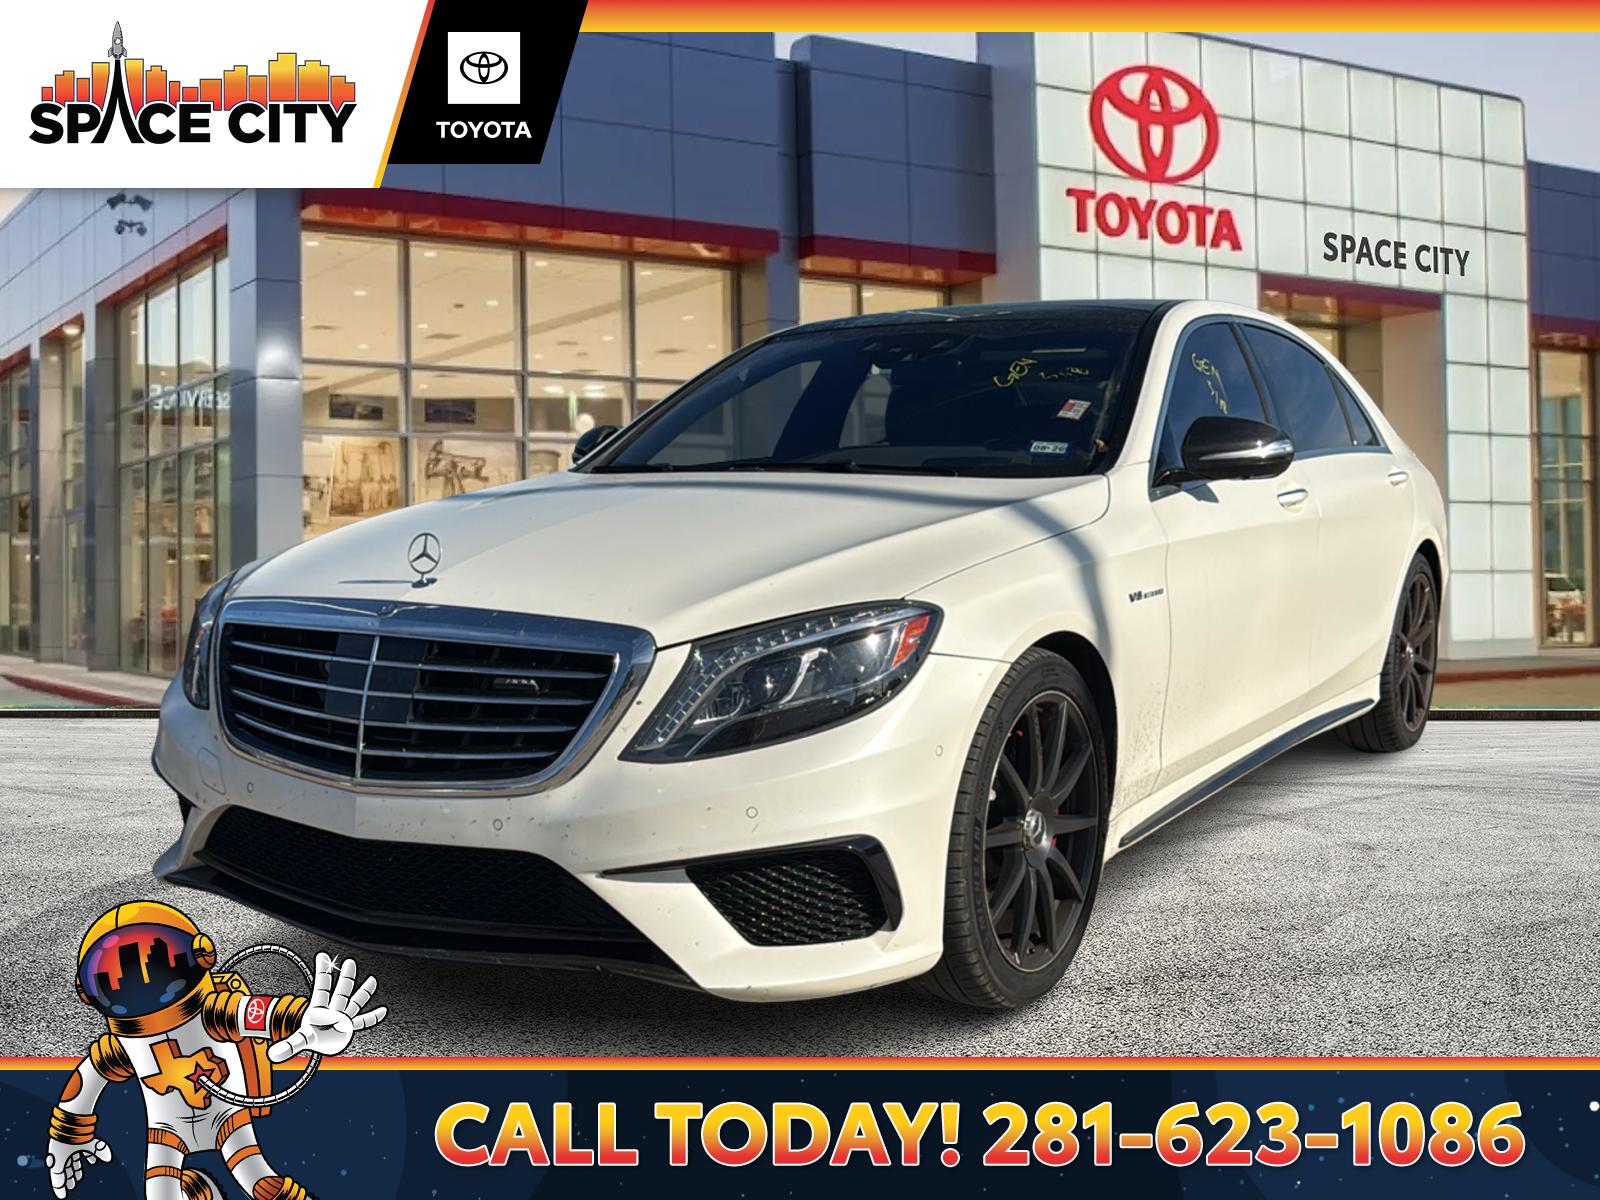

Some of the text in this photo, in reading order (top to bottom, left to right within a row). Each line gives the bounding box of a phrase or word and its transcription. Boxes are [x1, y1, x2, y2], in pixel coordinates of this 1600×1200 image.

[1066, 187, 1242, 251] TOYOTA
[1322, 231, 1471, 277] SPACE CITY
[1128, 590, 1143, 603] V8
